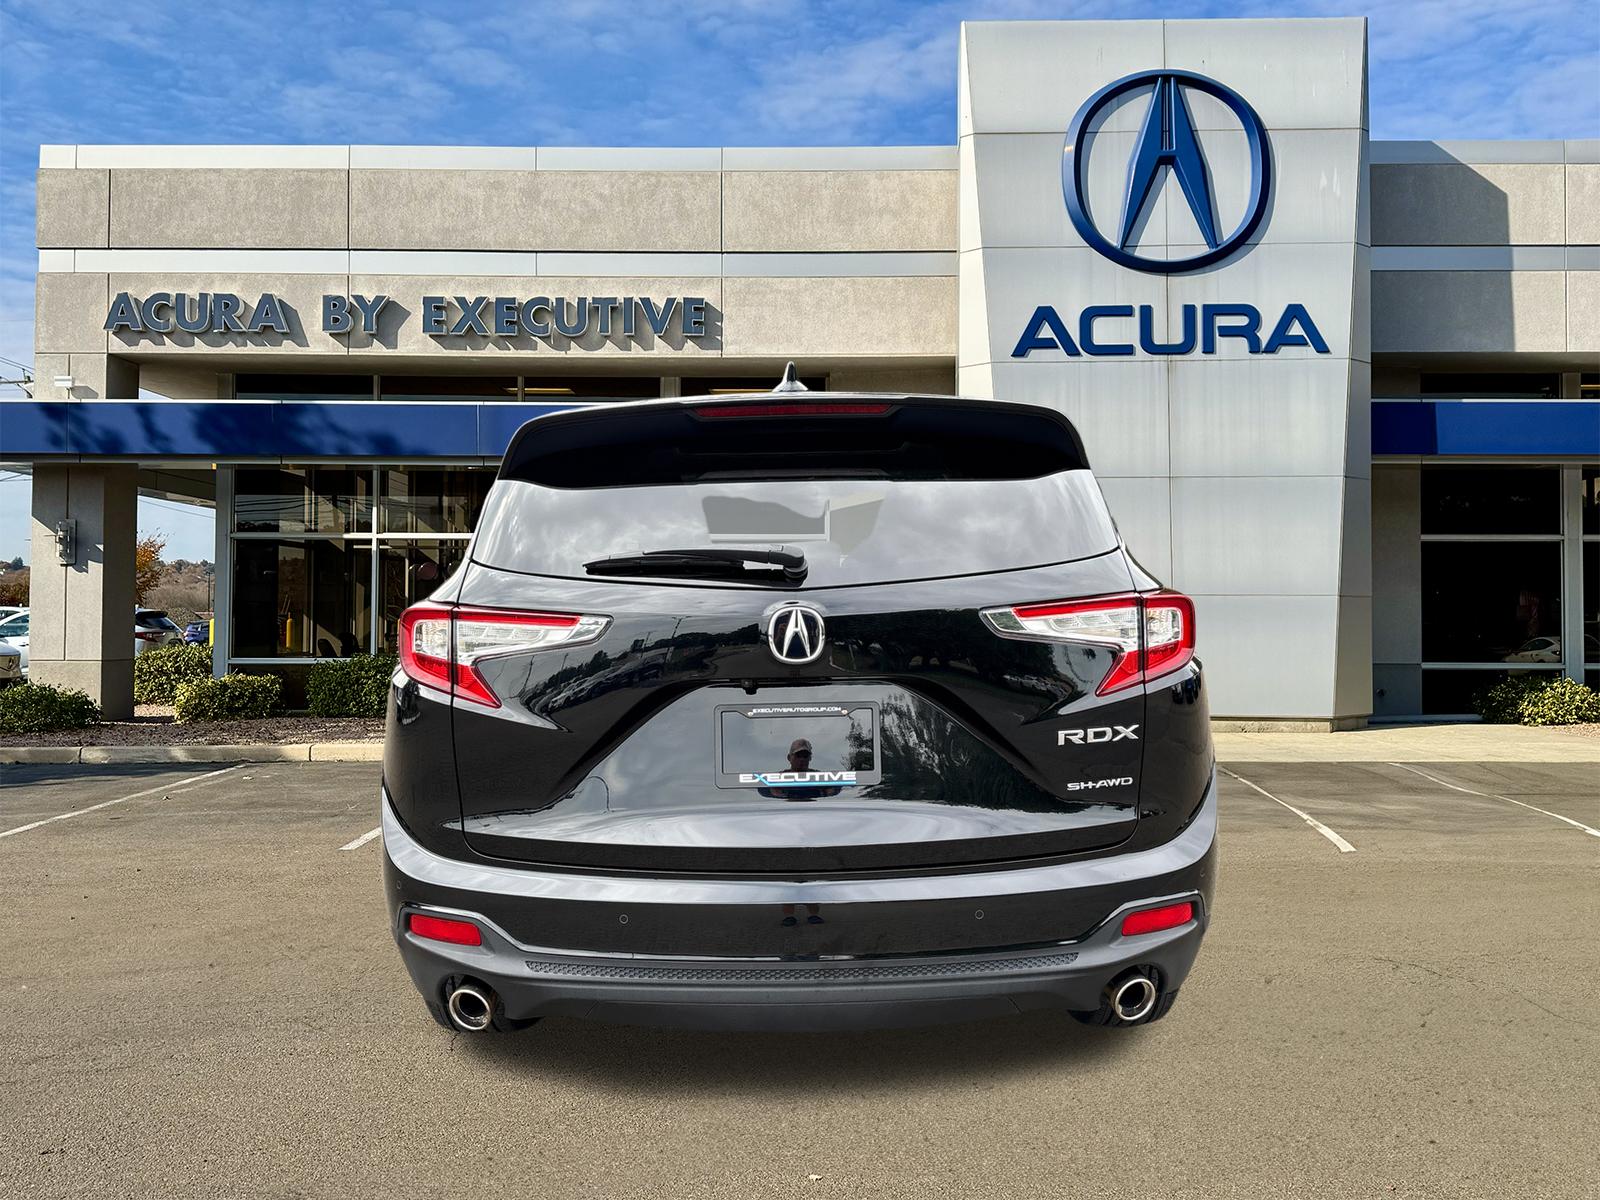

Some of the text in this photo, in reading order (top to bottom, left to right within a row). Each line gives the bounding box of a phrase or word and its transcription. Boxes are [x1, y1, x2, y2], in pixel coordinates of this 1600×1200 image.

[104, 292, 708, 337] ACURA BY EXECUTIVE
[1010, 303, 1331, 357] ACURA
[1057, 724, 1140, 746] RDX
[739, 771, 857, 787] EXECUTIVE
